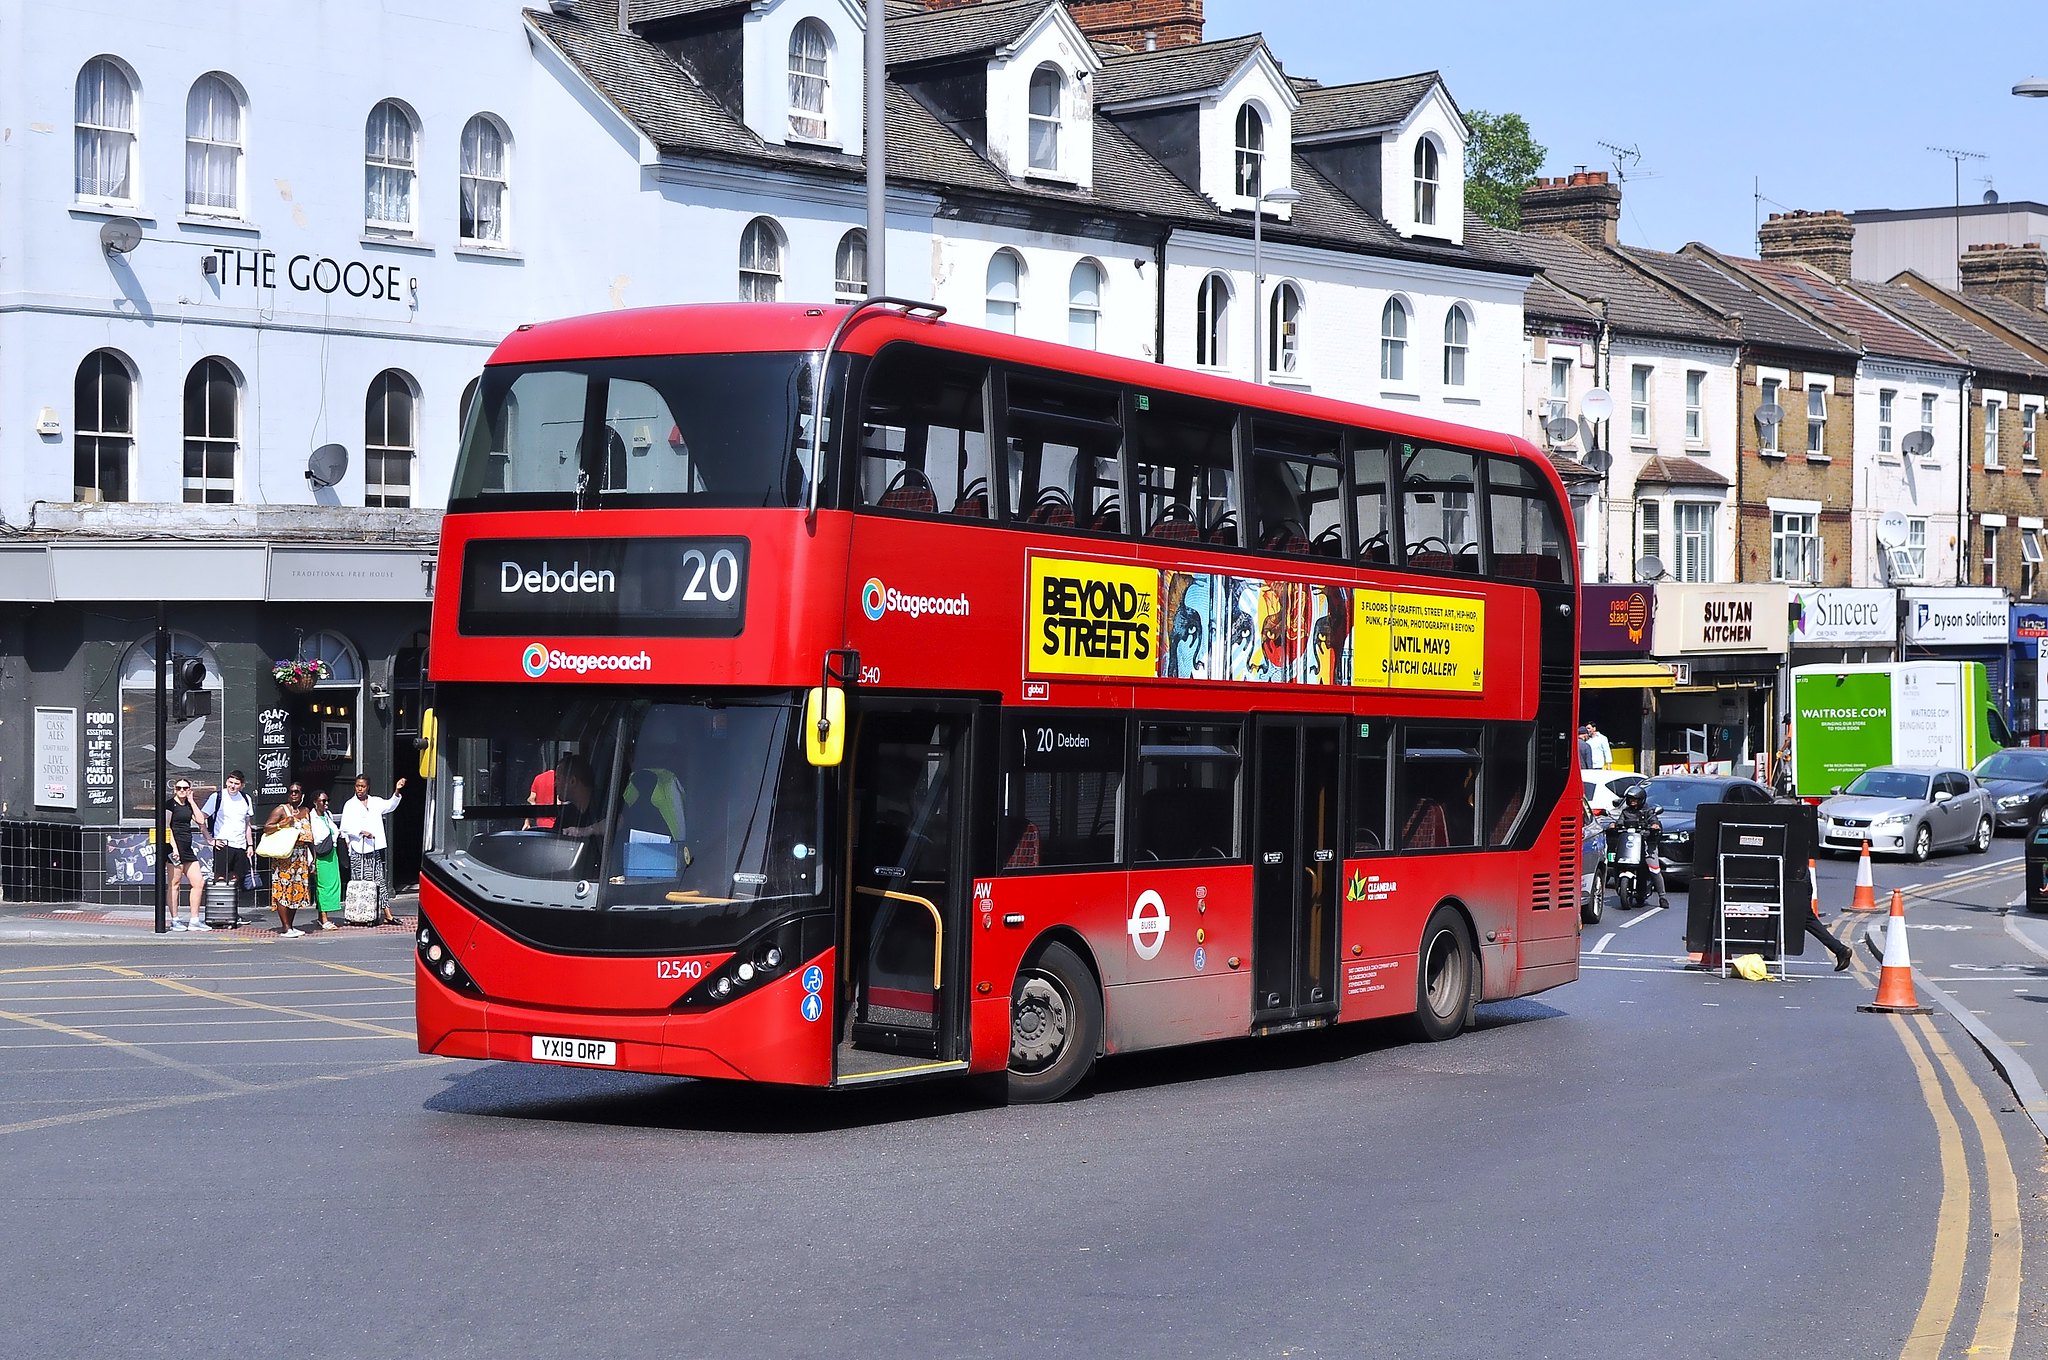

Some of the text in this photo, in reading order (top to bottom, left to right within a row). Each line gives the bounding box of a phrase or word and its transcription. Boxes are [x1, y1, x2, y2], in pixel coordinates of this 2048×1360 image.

[214, 248, 400, 302] THE GOOSE
[500, 561, 615, 593] Debden
[681, 549, 739, 602] 20
[886, 587, 970, 619] Stagecoach
[1042, 576, 1151, 620] BEYOND The
[1361, 601, 1478, 622] 3 FLOORS OF GRAFFITI, STREET ART, HIP-HOP,
[1610, 601, 1629, 611] naan
[1704, 601, 1753, 623] SULTAN
[1816, 593, 1879, 626] Sincere
[1365, 615, 1475, 632] PUNK, FASHION, PHOTOGRAPHY & BEYOND
[1609, 611, 1629, 625] staap
[1934, 611, 2006, 631] Dyson Solicitors
[2020, 618, 2046, 630] kings
[1042, 617, 1150, 660] STREETS
[1703, 625, 1752, 643] KITCHEN
[1394, 636, 1450, 655] UNTIL MAY 9
[549, 650, 651, 675] Stagecoach
[1382, 659, 1458, 677] SAATCHI GALLERY
[1027, 684, 1044, 697] global
[86, 712, 114, 724] FOOD
[259, 708, 289, 723] CRAFT
[1801, 708, 1887, 718] WAITROSE.COM
[46, 721, 65, 731] CASK
[264, 720, 284, 734] Beer
[48, 731, 64, 740] ALES
[262, 734, 285, 744] HERE
[298, 732, 342, 746] GREAT
[1037, 727, 1090, 752] 20 Debden
[88, 741, 112, 750] LIFE
[48, 755, 63, 765] LIVE
[302, 748, 339, 762] FOOD
[43, 764, 69, 775] SPORTS
[86, 774, 114, 785] GOOD
[141, 779, 156, 789] TH
[261, 787, 287, 795] PROSECCO
[974, 882, 992, 899] AW
[1141, 921, 1157, 929] BUSES
[657, 960, 702, 979] 12540
[541, 1039, 606, 1060] YX19 ORP
